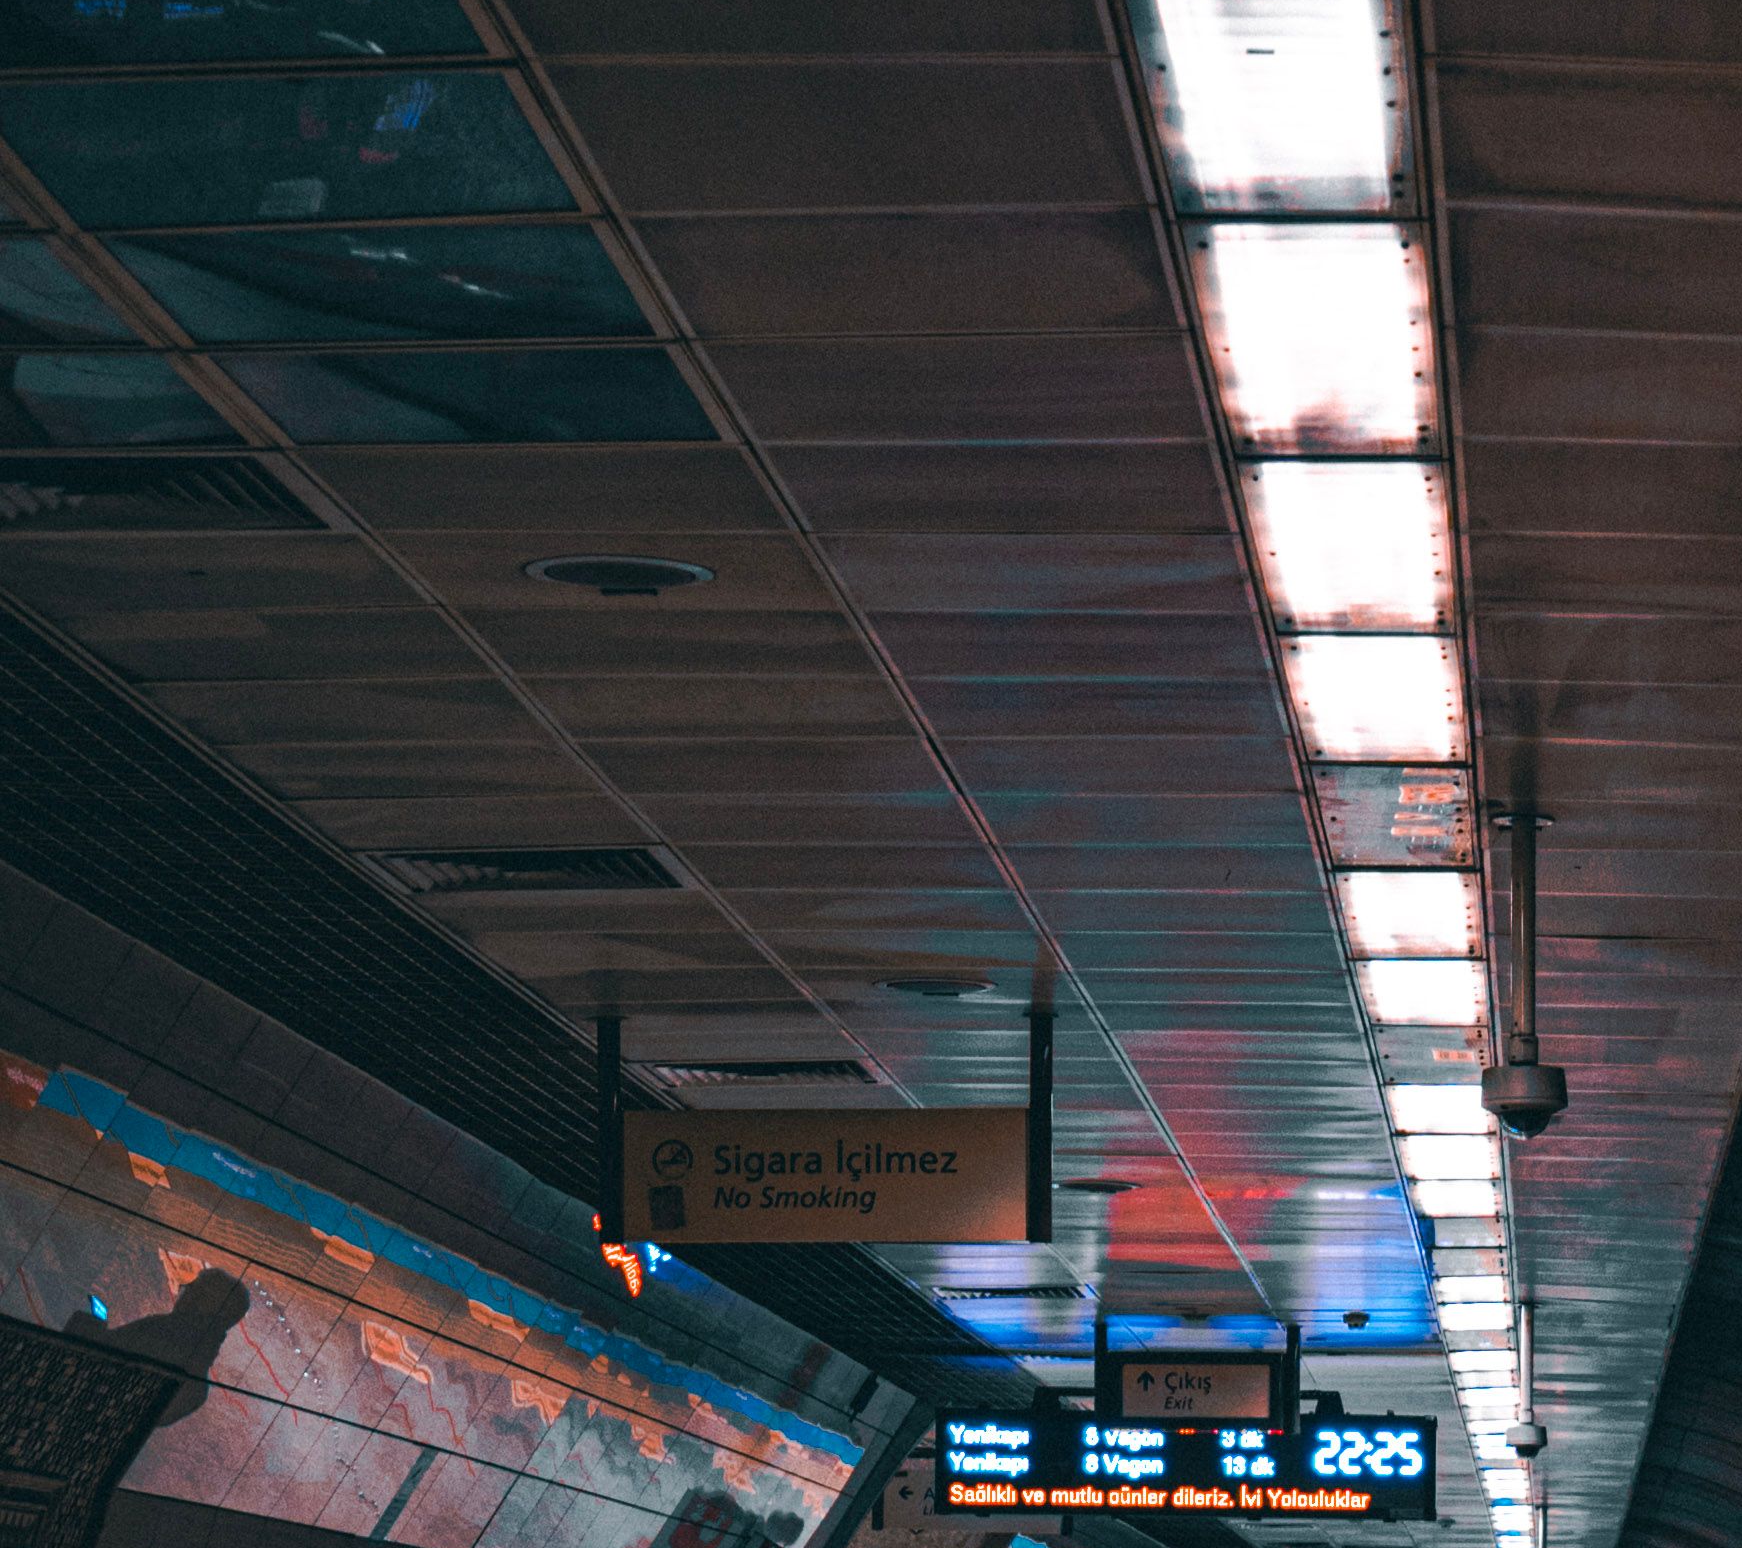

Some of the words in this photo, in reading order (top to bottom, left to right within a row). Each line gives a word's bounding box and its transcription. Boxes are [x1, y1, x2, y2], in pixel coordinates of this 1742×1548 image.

[713, 1143, 823, 1183] Sigara
[836, 1139, 959, 1182] İçilmez
[713, 1186, 752, 1210] No
[759, 1185, 877, 1214] Smoking
[1164, 1371, 1212, 1394] Çıkış
[1164, 1396, 1194, 1410] Exit
[1085, 1453, 1100, 1473] 8
[1222, 1455, 1246, 1476] 13
[1313, 1431, 1423, 1476] 22:25
[1022, 1489, 1045, 1503] ve
[1051, 1486, 1103, 1505] mutlu
